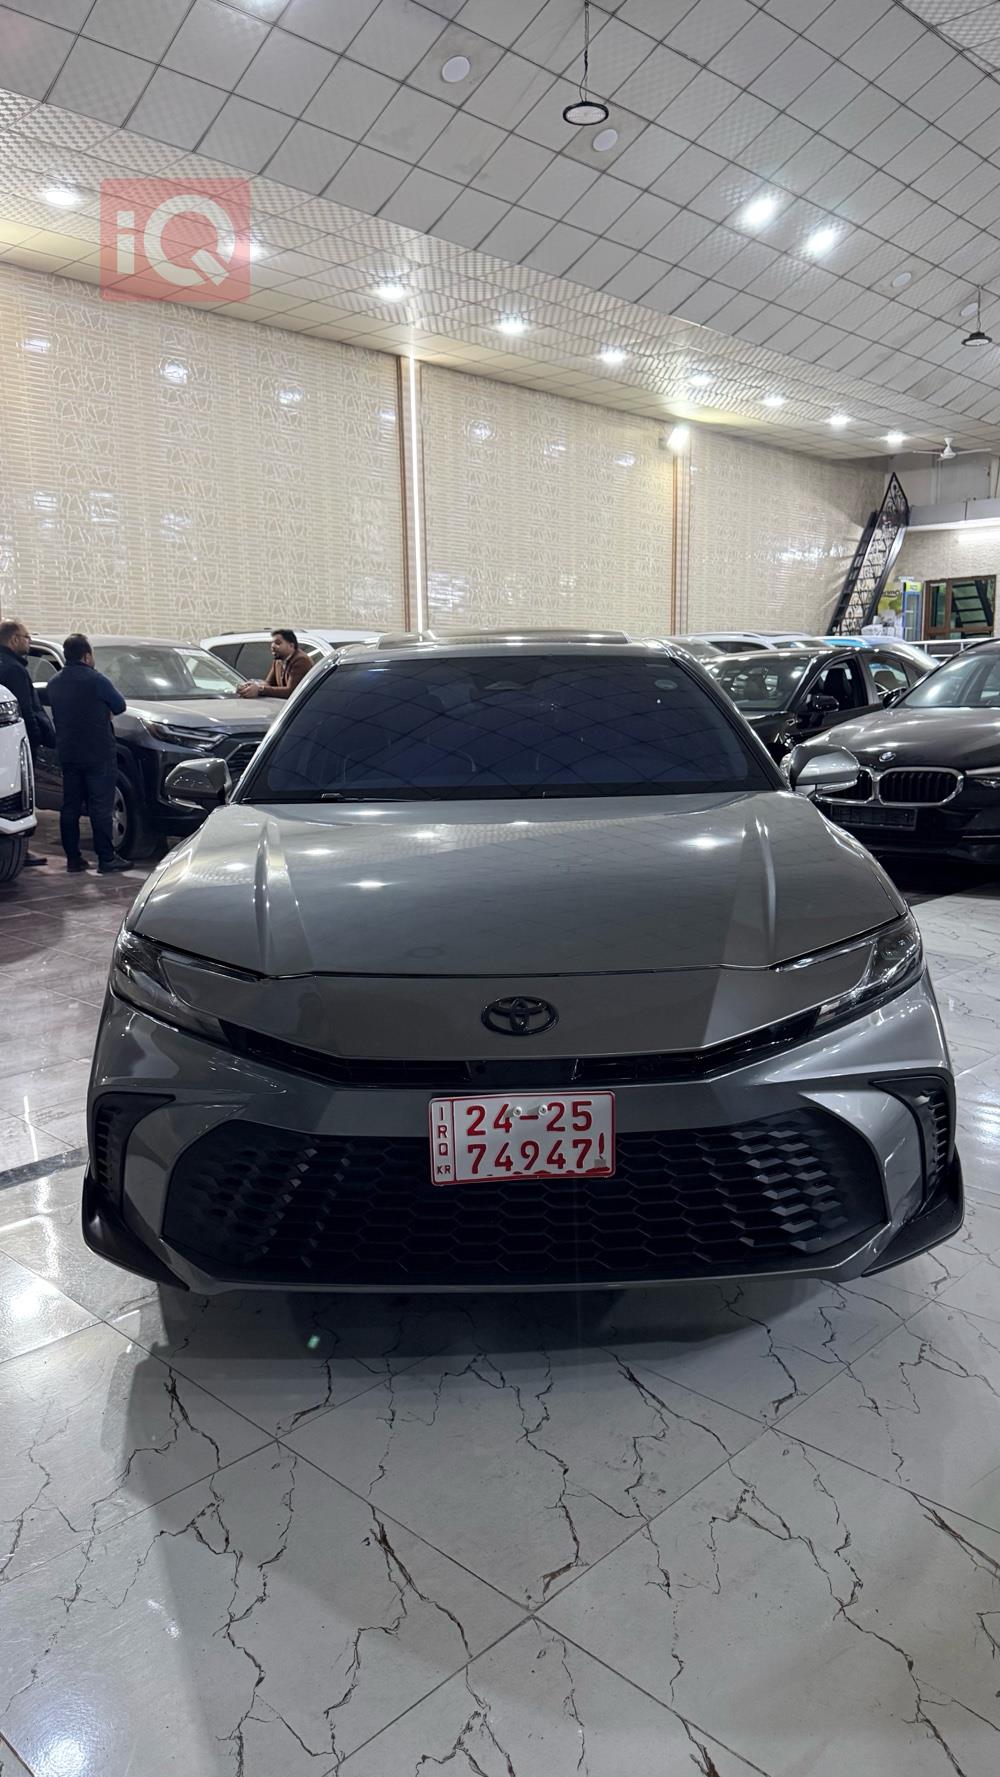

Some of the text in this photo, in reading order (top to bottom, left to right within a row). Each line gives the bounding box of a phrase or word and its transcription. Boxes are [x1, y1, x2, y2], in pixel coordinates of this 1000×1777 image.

[436, 1106, 449, 1156] IRQ
[436, 1165, 451, 1175] KR
[467, 1138, 593, 1174] 74947
